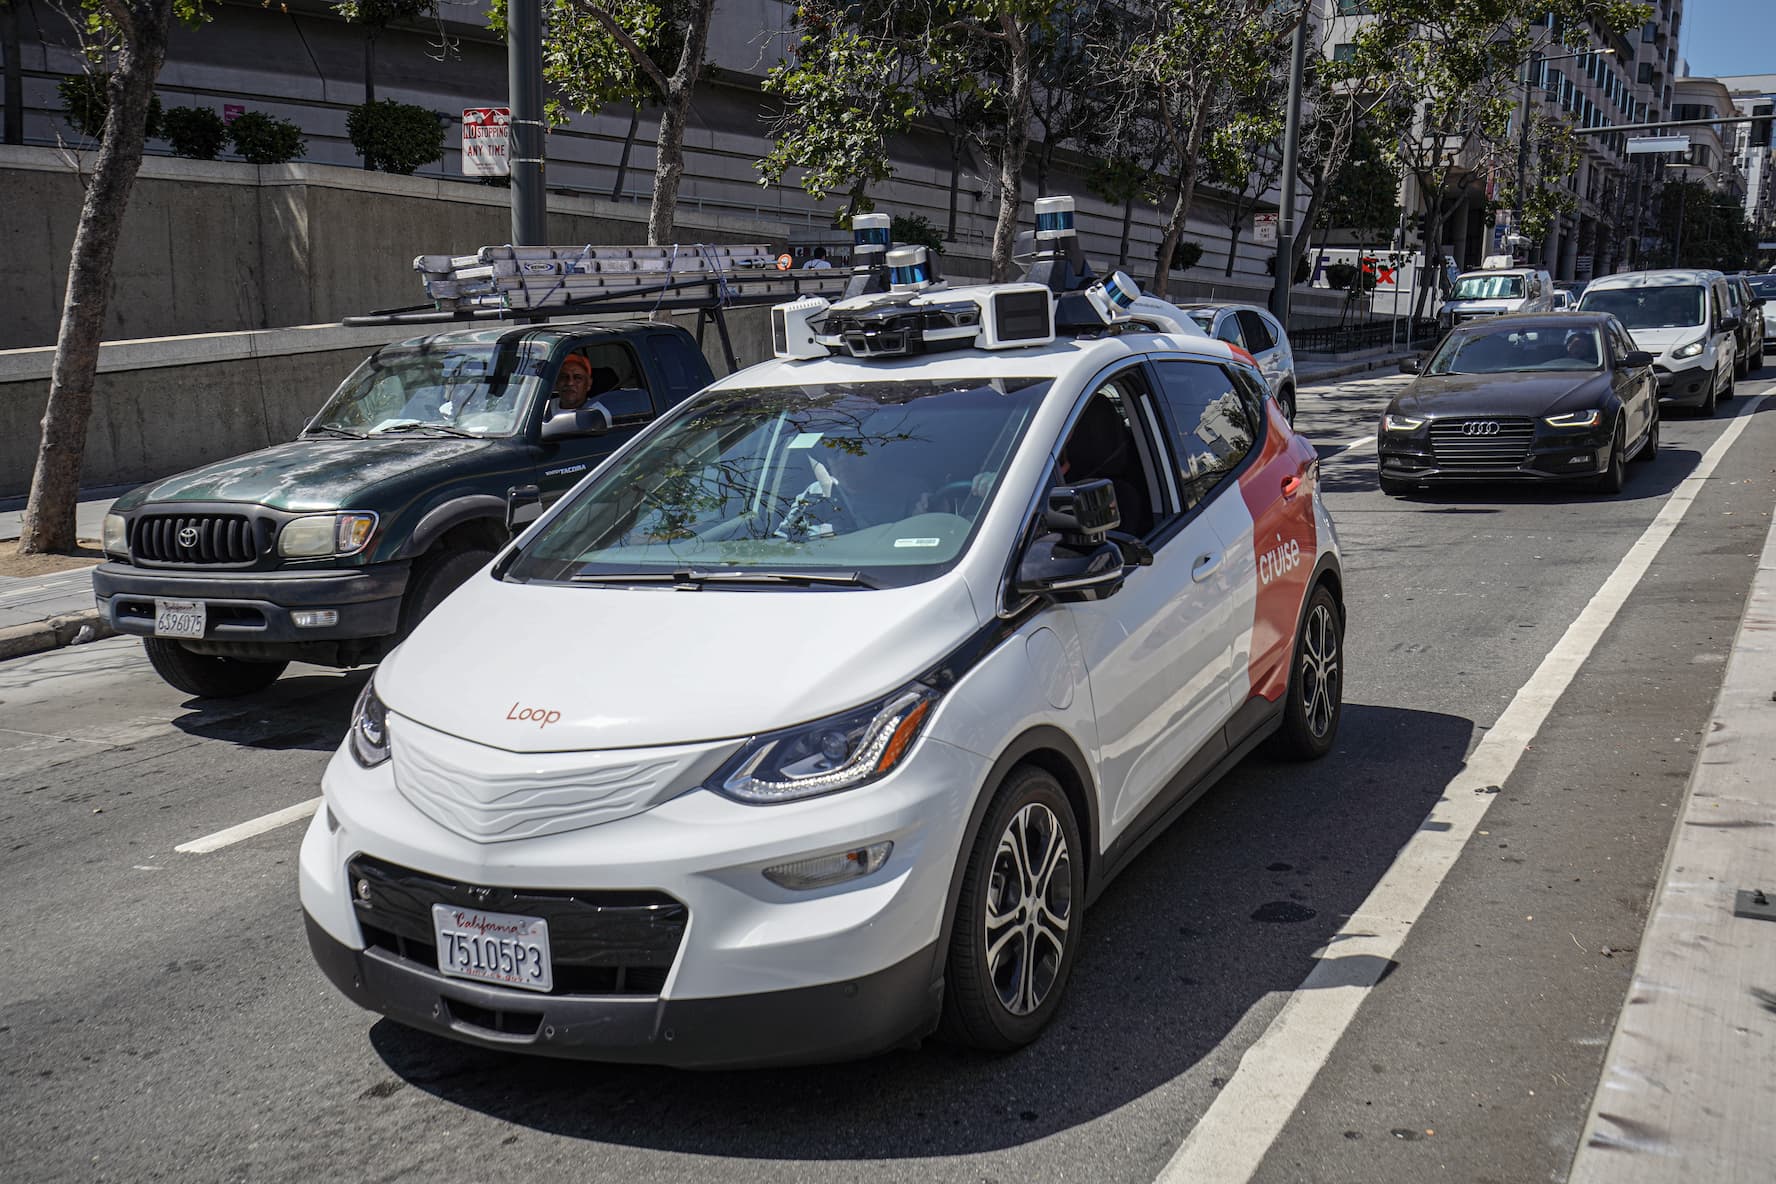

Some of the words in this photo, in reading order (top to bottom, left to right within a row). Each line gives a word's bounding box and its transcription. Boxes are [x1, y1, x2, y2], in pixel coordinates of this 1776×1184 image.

[464, 124, 476, 138] NO
[478, 126, 508, 138] STOPPING
[467, 145, 483, 157] ANY
[488, 144, 505, 156] TIME
[1260, 533, 1300, 585] cruise
[506, 701, 561, 729] Loop
[455, 911, 519, 936] California
[442, 931, 543, 978] 75105P3
